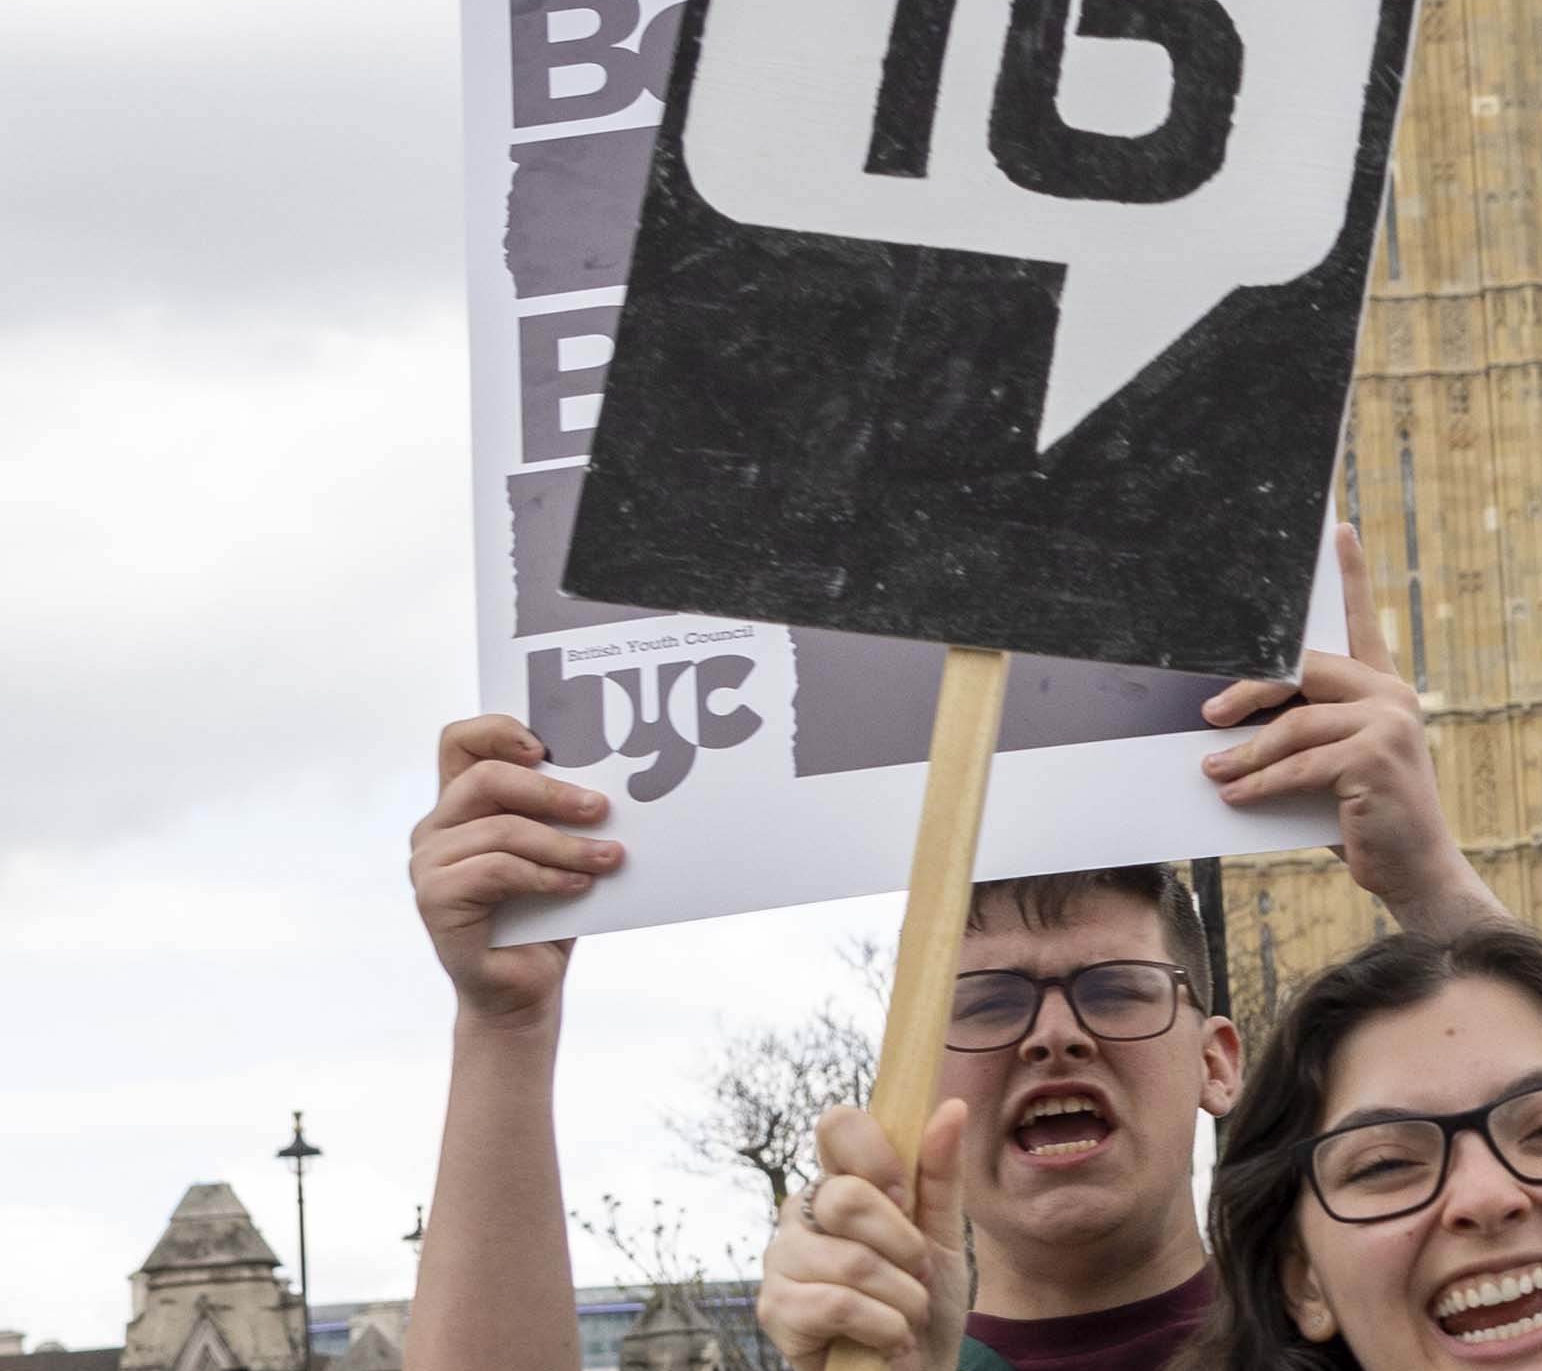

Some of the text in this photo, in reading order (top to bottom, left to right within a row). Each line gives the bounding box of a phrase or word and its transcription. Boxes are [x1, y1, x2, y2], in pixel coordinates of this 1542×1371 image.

[518, 305, 626, 464] B
[567, 625, 755, 663] British Youth Council
[527, 647, 763, 803] byc
